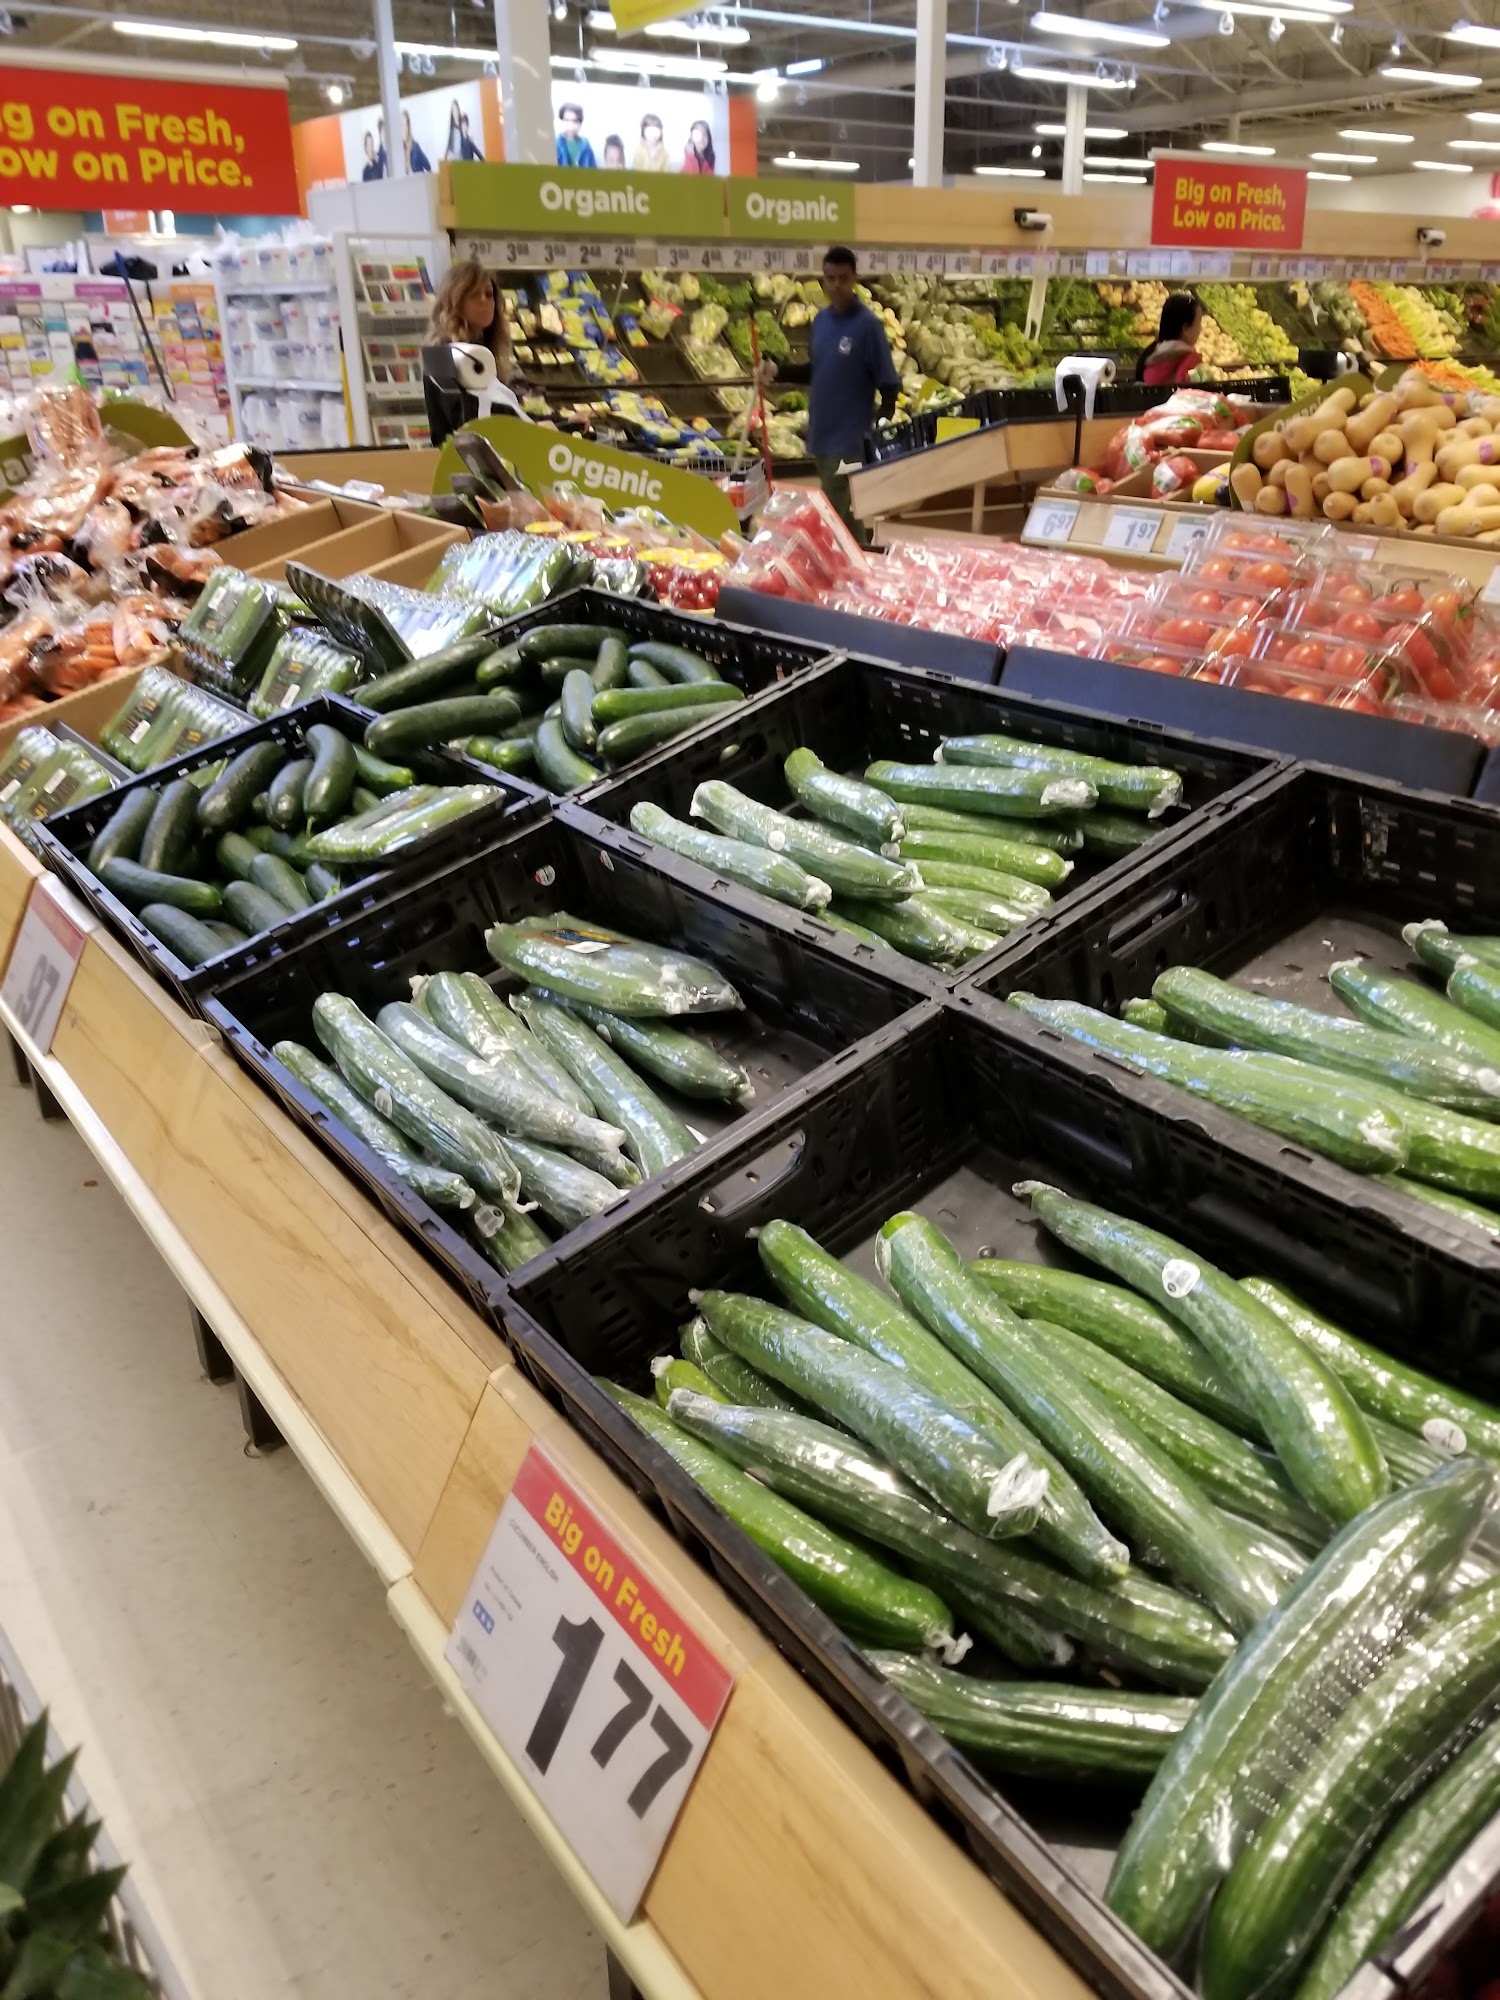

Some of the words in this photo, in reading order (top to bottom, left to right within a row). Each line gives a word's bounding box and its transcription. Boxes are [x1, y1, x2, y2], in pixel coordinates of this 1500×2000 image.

[47, 105, 105, 140] on
[115, 103, 245, 153] Fresh,
[72, 150, 129, 183] on
[138, 147, 254, 187] Price.
[540, 181, 650, 217] Organic
[746, 192, 839, 224] Organic
[1175, 177, 1206, 206] Big
[1209, 184, 1232, 203] on
[1236, 181, 1286, 211] Fresh,
[1173, 204, 1210, 228] Low
[1214, 210, 1236, 229] on
[1240, 208, 1285, 232] Price.
[548, 444, 663, 501] Organic
[544, 1492, 583, 1556] Big
[584, 1546, 615, 1593] on
[615, 1576, 686, 1677] Fresh
